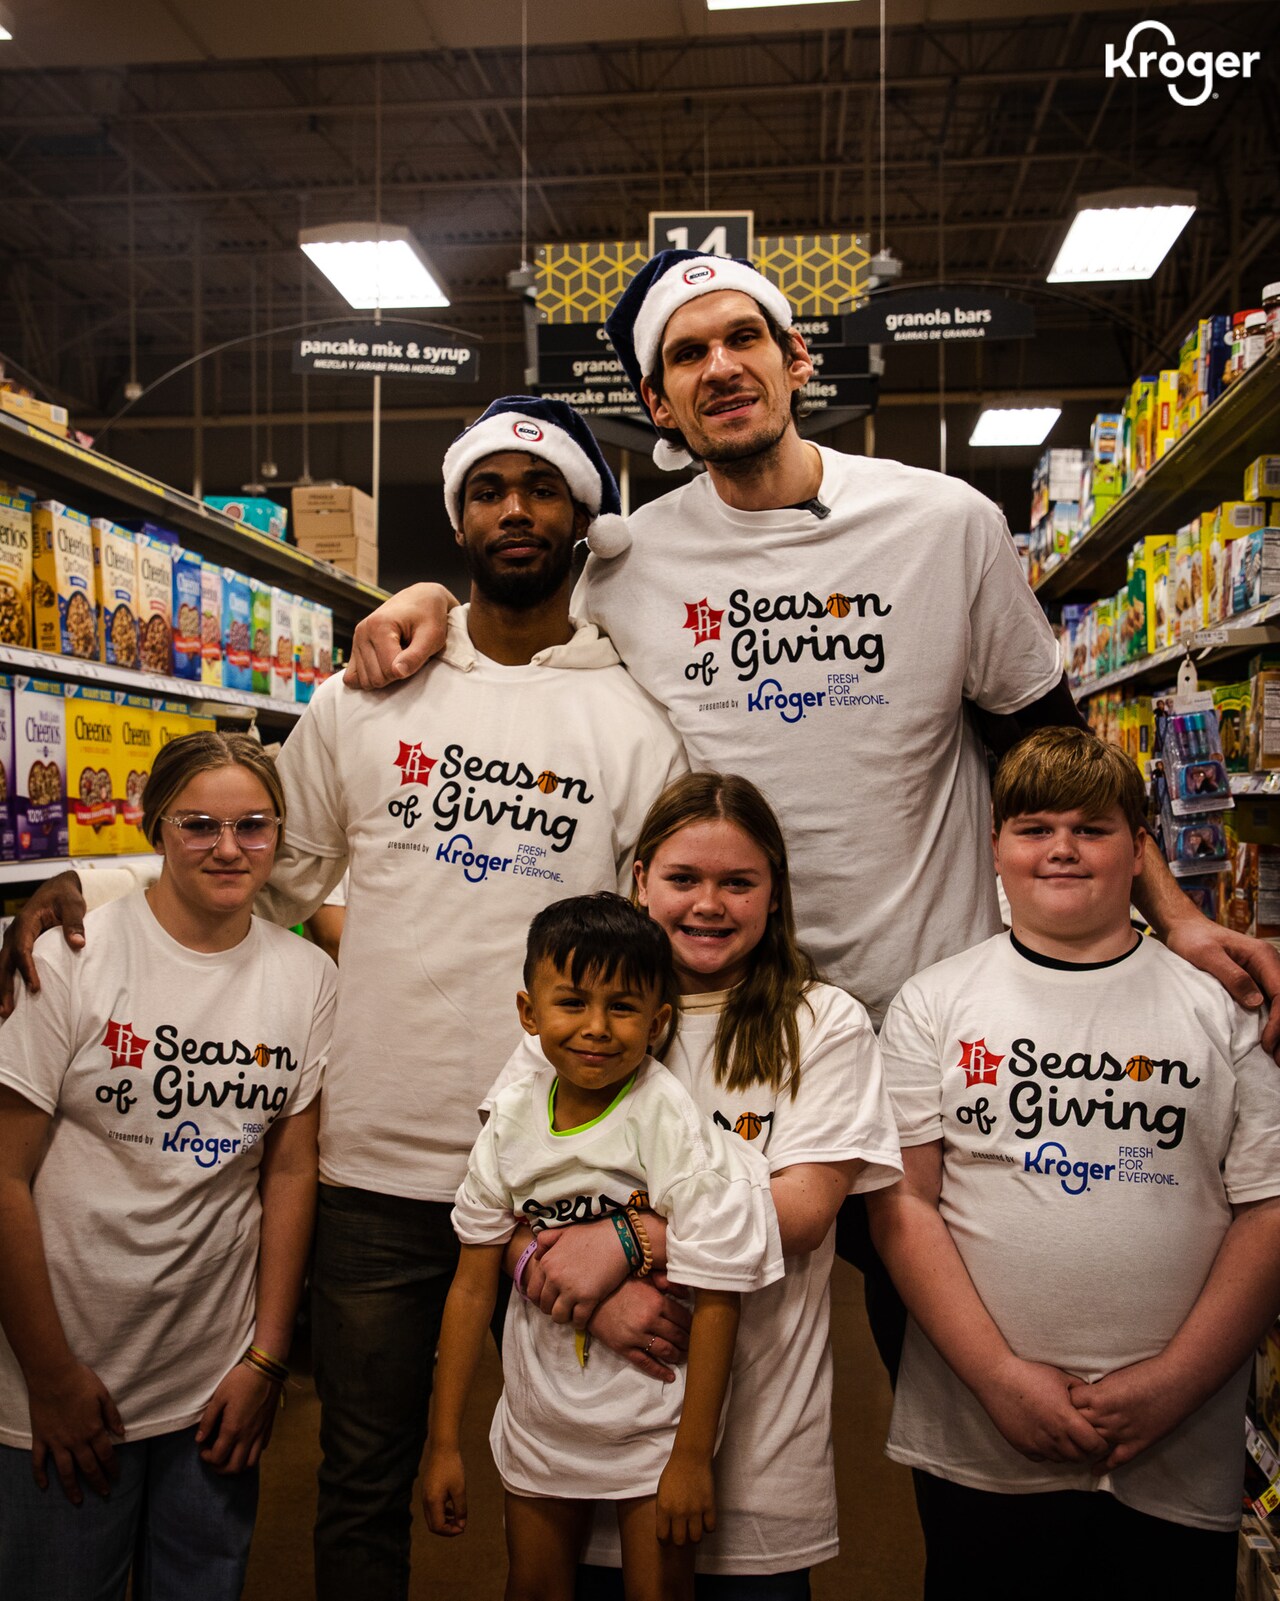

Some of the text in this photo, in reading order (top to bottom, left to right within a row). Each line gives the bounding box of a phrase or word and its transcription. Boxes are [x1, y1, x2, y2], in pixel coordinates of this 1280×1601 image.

[885, 307, 991, 331] granola bars
[894, 327, 985, 341] BARRAS DE GRANOLA
[301, 338, 471, 364] pancake mix & syrup
[607, 387, 637, 403] mix
[685, 624, 885, 686] of Giving
[827, 674, 859, 684] FRESH
[828, 685, 850, 695] FOR
[699, 678, 826, 724] presented by Kroger
[26, 717, 61, 745] Cheerios
[75, 715, 112, 743] Cheerios
[388, 781, 579, 853] of Giving
[387, 834, 513, 883] presented by Kroger
[515, 855, 537, 867] FOR
[518, 844, 547, 858] FRESH
[95, 1065, 289, 1123] of Giving
[956, 1081, 1187, 1150] of Giving
[108, 1130, 143, 1144] presented
[145, 1133, 154, 1146] by
[162, 1121, 241, 1168] Kroger
[1119, 1147, 1154, 1159] FRESH
[1024, 1142, 1116, 1195] Kroger
[1119, 1159, 1143, 1171] FOR
